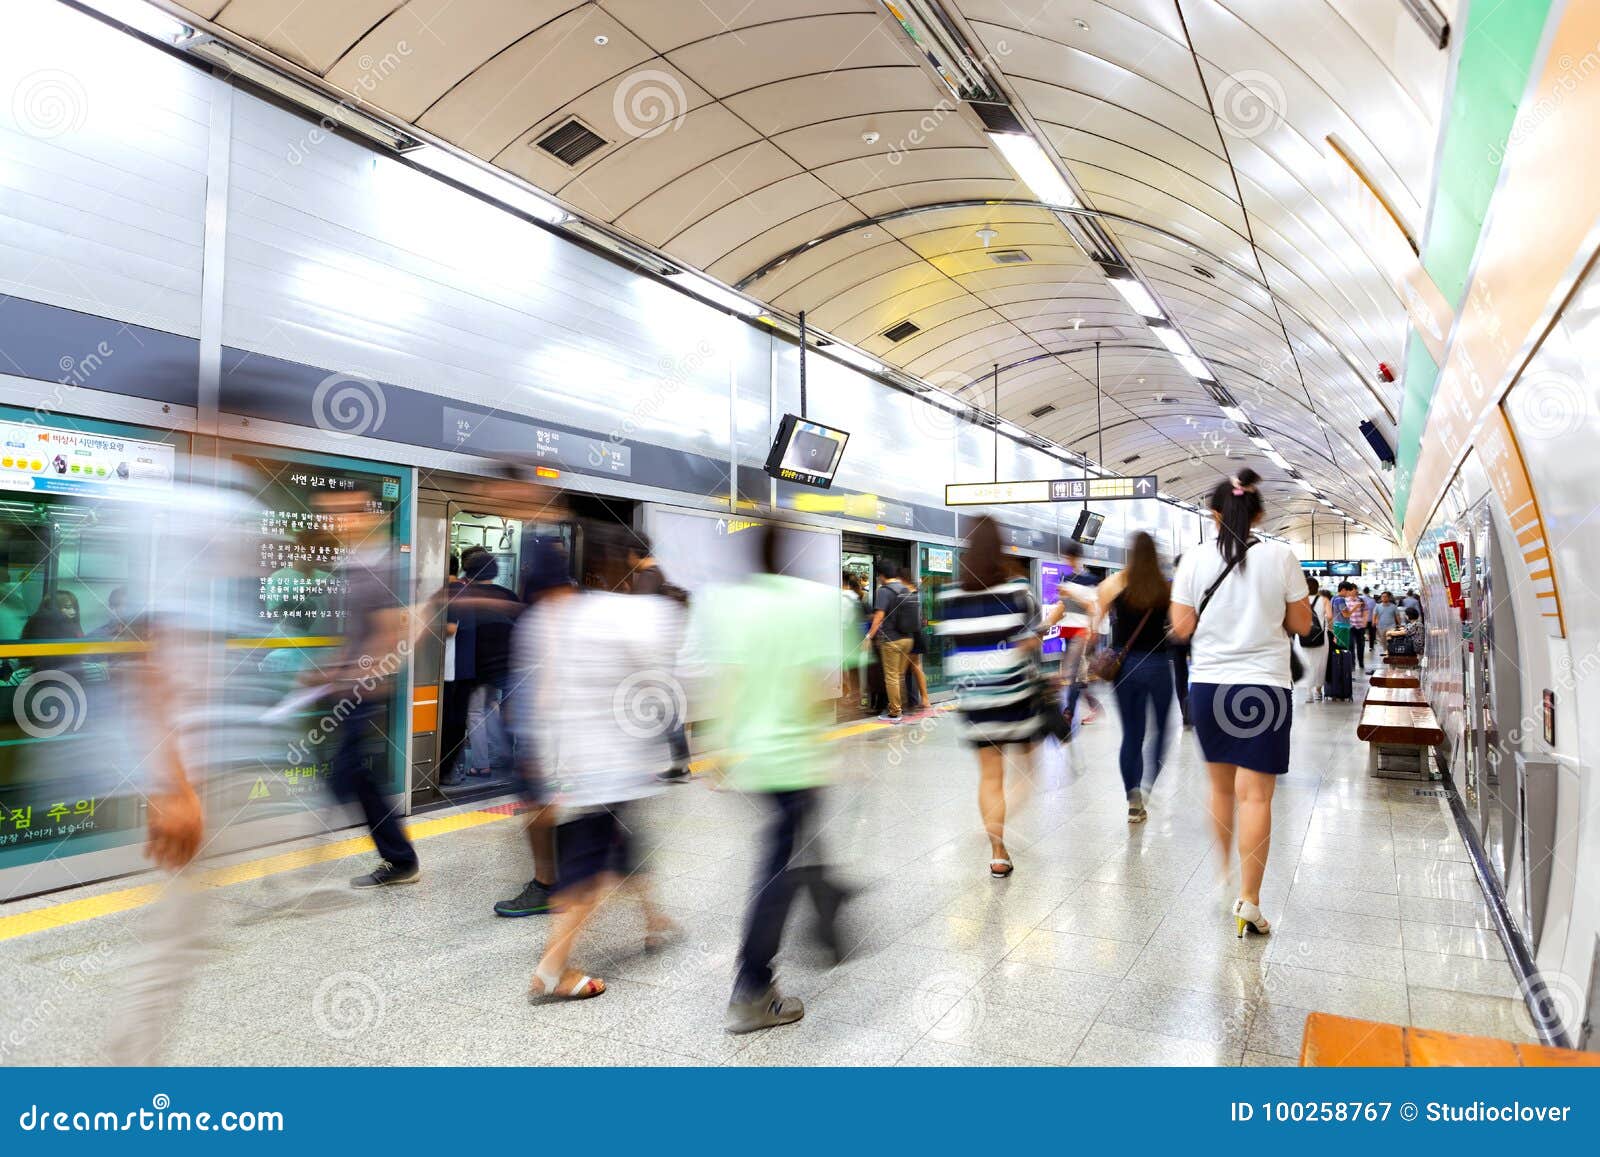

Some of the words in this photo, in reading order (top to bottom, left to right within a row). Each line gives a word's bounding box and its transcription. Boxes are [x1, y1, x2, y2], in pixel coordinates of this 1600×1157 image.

[52, 434, 77, 447] 비상시
[78, 437, 125, 452] 시민행동요령
[291, 474, 307, 485] 사연
[310, 476, 326, 487] 싣고
[328, 478, 337, 489] 한
[260, 610, 279, 619] 오늘도
[282, 610, 302, 619] 우리의
[304, 610, 317, 619] 사연
[46, 796, 95, 823] 주의
[24, 827, 52, 839] 사이가
